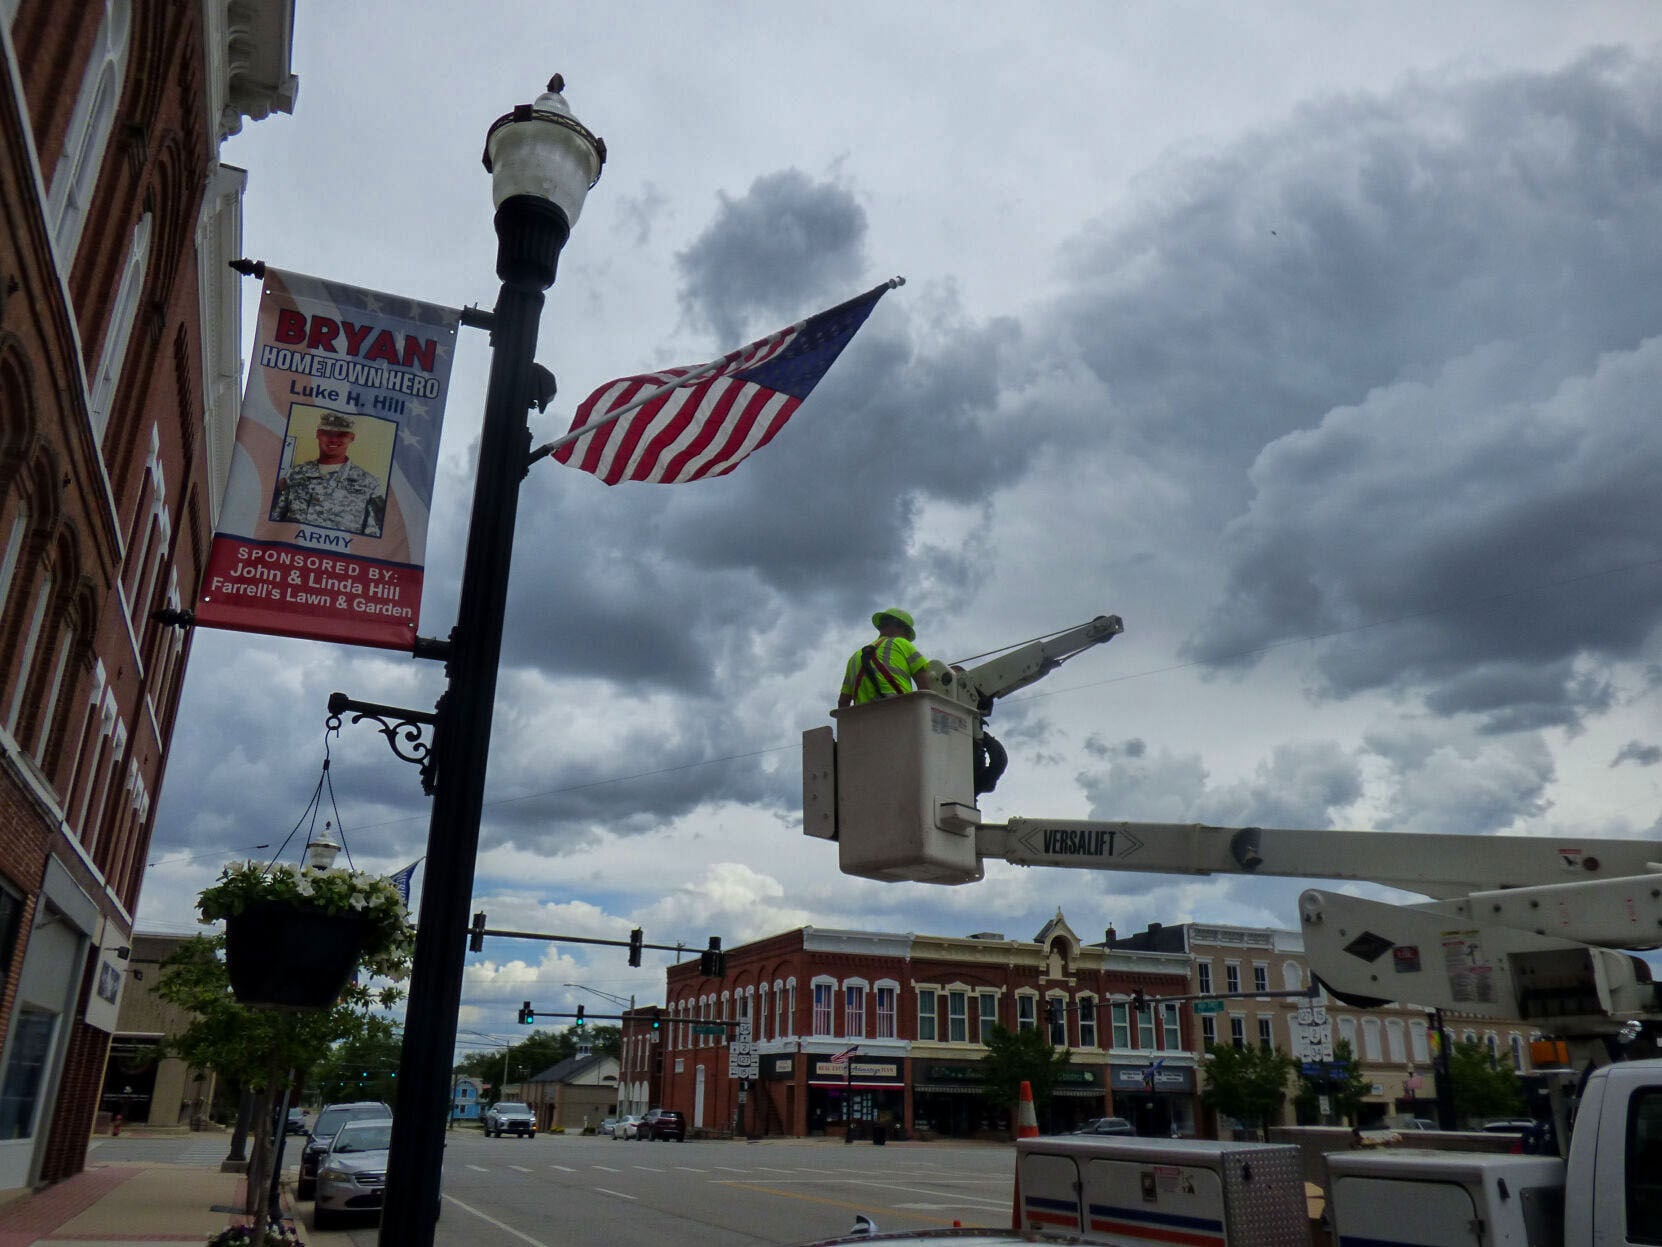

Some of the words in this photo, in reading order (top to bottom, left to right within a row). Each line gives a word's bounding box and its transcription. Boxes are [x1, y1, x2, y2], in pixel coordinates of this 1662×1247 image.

[275, 308, 437, 372] BRYAN
[261, 344, 386, 389] HOMETOWN
[387, 370, 440, 399] HERO
[290, 380, 340, 401] Luke
[346, 390, 365, 407] H.
[373, 394, 405, 415] Hill
[294, 529, 353, 548] ARMY
[230, 563, 281, 581] John
[287, 570, 301, 585] &
[309, 572, 362, 594] Linda
[369, 582, 400, 600] Hill
[237, 547, 360, 576] SPONSORED
[369, 567, 399, 582] BY:
[211, 576, 281, 600] Farrell's
[286, 587, 330, 607] Lawn
[336, 595, 348, 609] &
[353, 598, 412, 618] Garden
[1044, 829, 1117, 856] VERSALIFT
